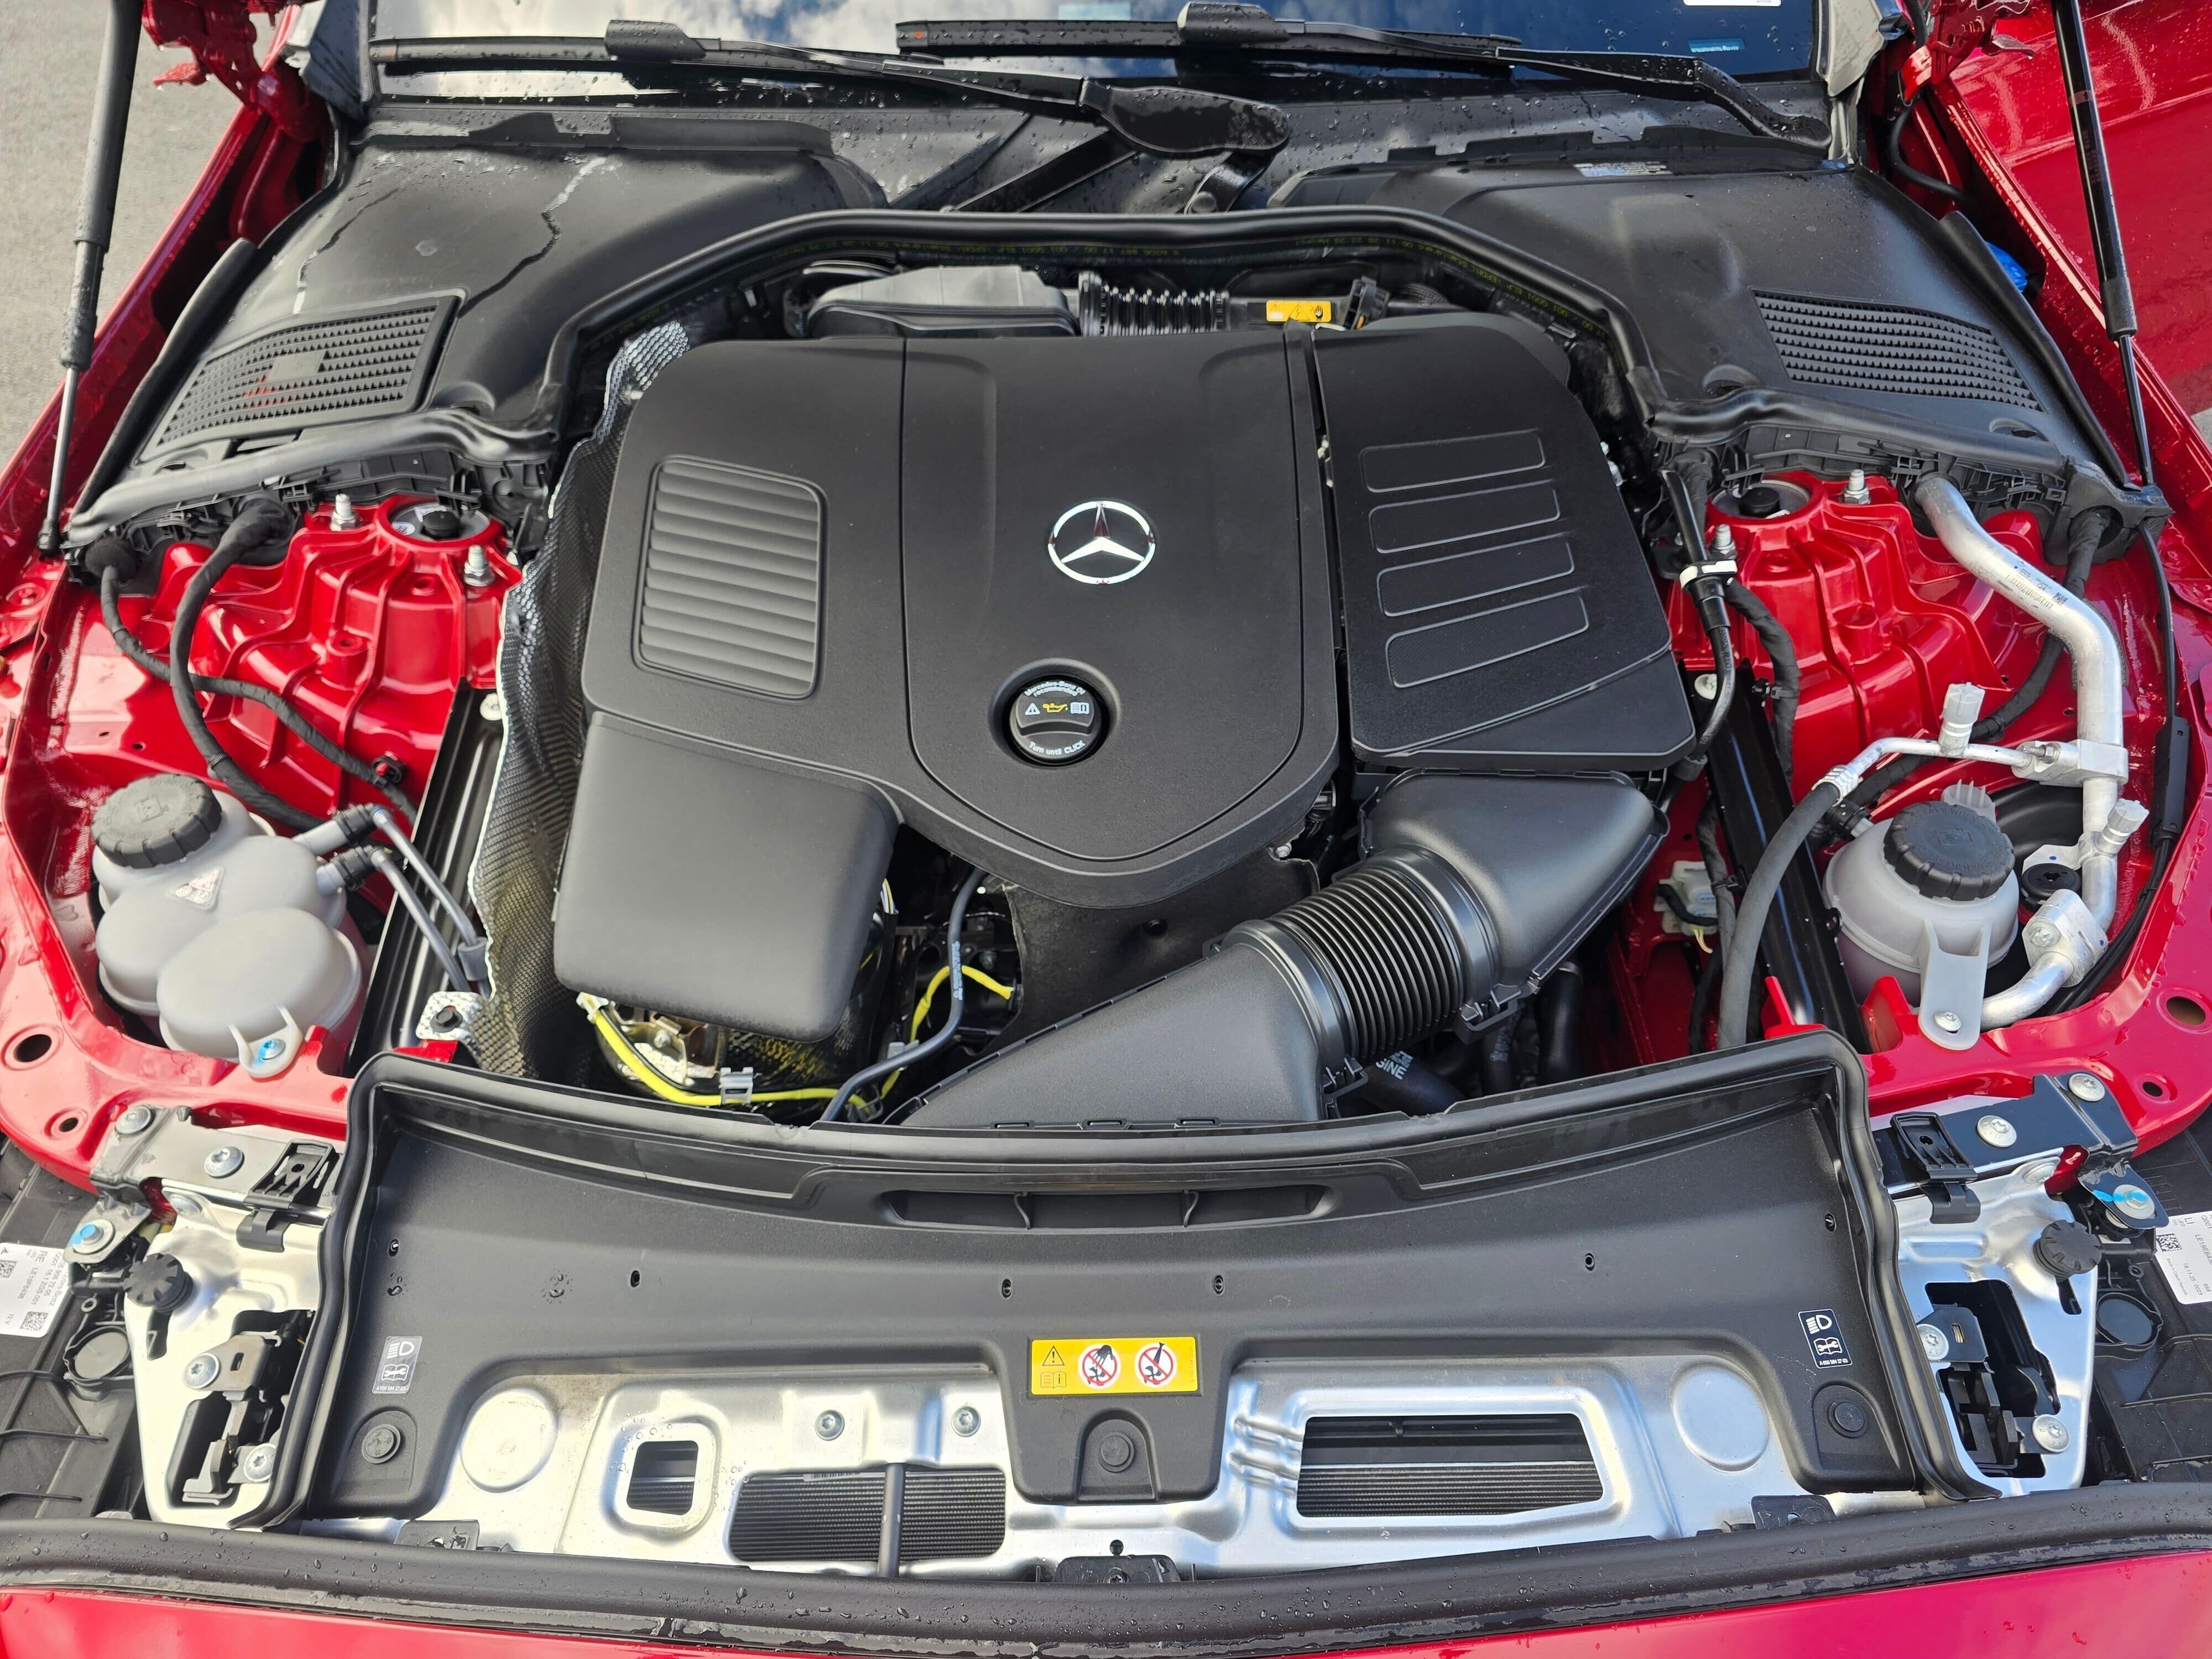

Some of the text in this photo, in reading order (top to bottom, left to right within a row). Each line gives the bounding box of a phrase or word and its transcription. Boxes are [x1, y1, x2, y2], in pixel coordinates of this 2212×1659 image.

[1024, 681, 1077, 696] Mercedes-Benz
[1029, 742, 1044, 754] Turn
[1064, 740, 1086, 754] CLICK
